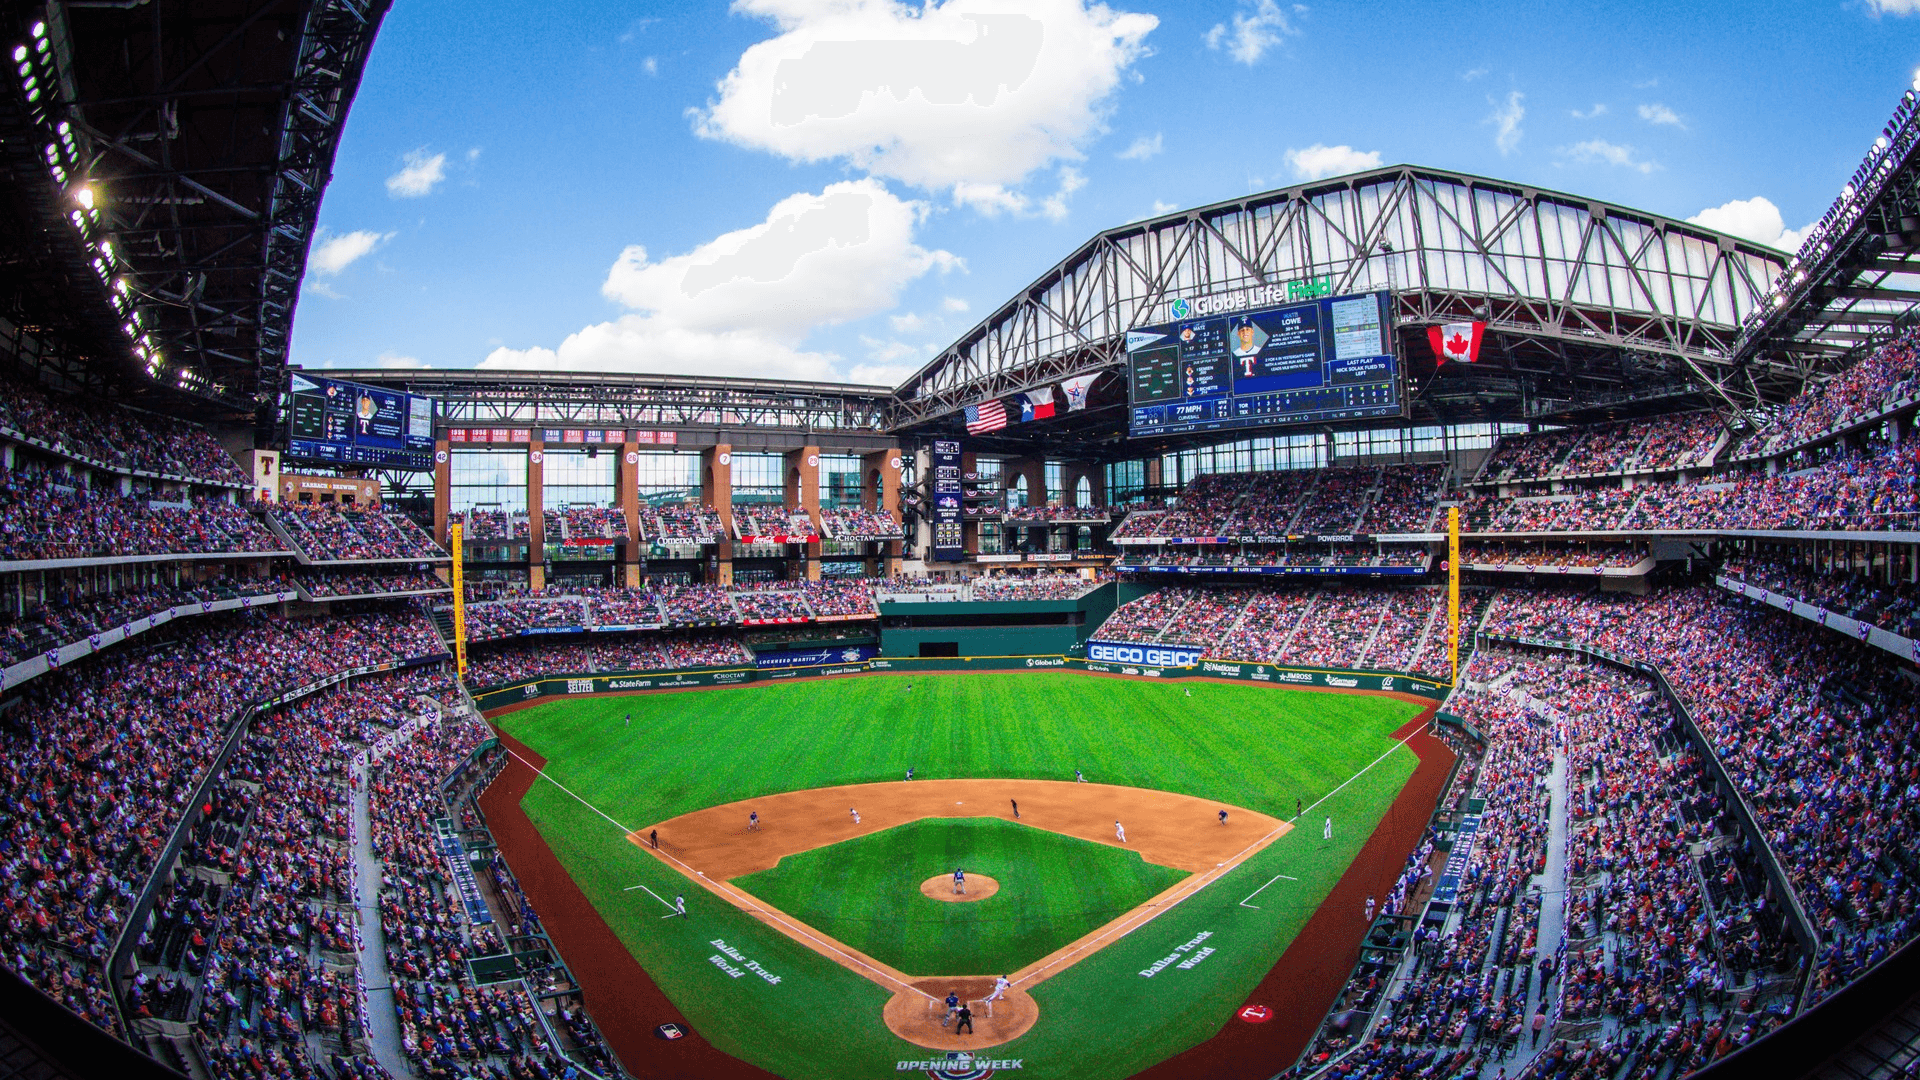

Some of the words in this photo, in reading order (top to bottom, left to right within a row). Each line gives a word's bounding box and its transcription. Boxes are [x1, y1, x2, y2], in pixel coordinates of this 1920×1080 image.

[1194, 293, 1246, 314] Globe
[1250, 285, 1284, 304] Life
[1288, 276, 1330, 299] Field
[1282, 317, 1301, 326] LOWE
[1240, 357, 1257, 377] T
[1186, 405, 1202, 413] MPH
[360, 420, 369, 434] T
[260, 456, 274, 475] T
[1090, 646, 1143, 663] GEICO
[1146, 650, 1200, 666] GEICO
[1212, 664, 1240, 672] National
[524, 685, 538, 694] UTA
[568, 683, 594, 693] SELTZER
[710, 939, 746, 962] Dallas
[744, 960, 781, 985] Truck
[1138, 953, 1181, 978] Dallas
[1175, 931, 1214, 952] Truck
[1176, 947, 1216, 969] World
[709, 955, 745, 978] World
[896, 1060, 970, 1070] OPENING
[975, 1059, 1023, 1070] WEEK
